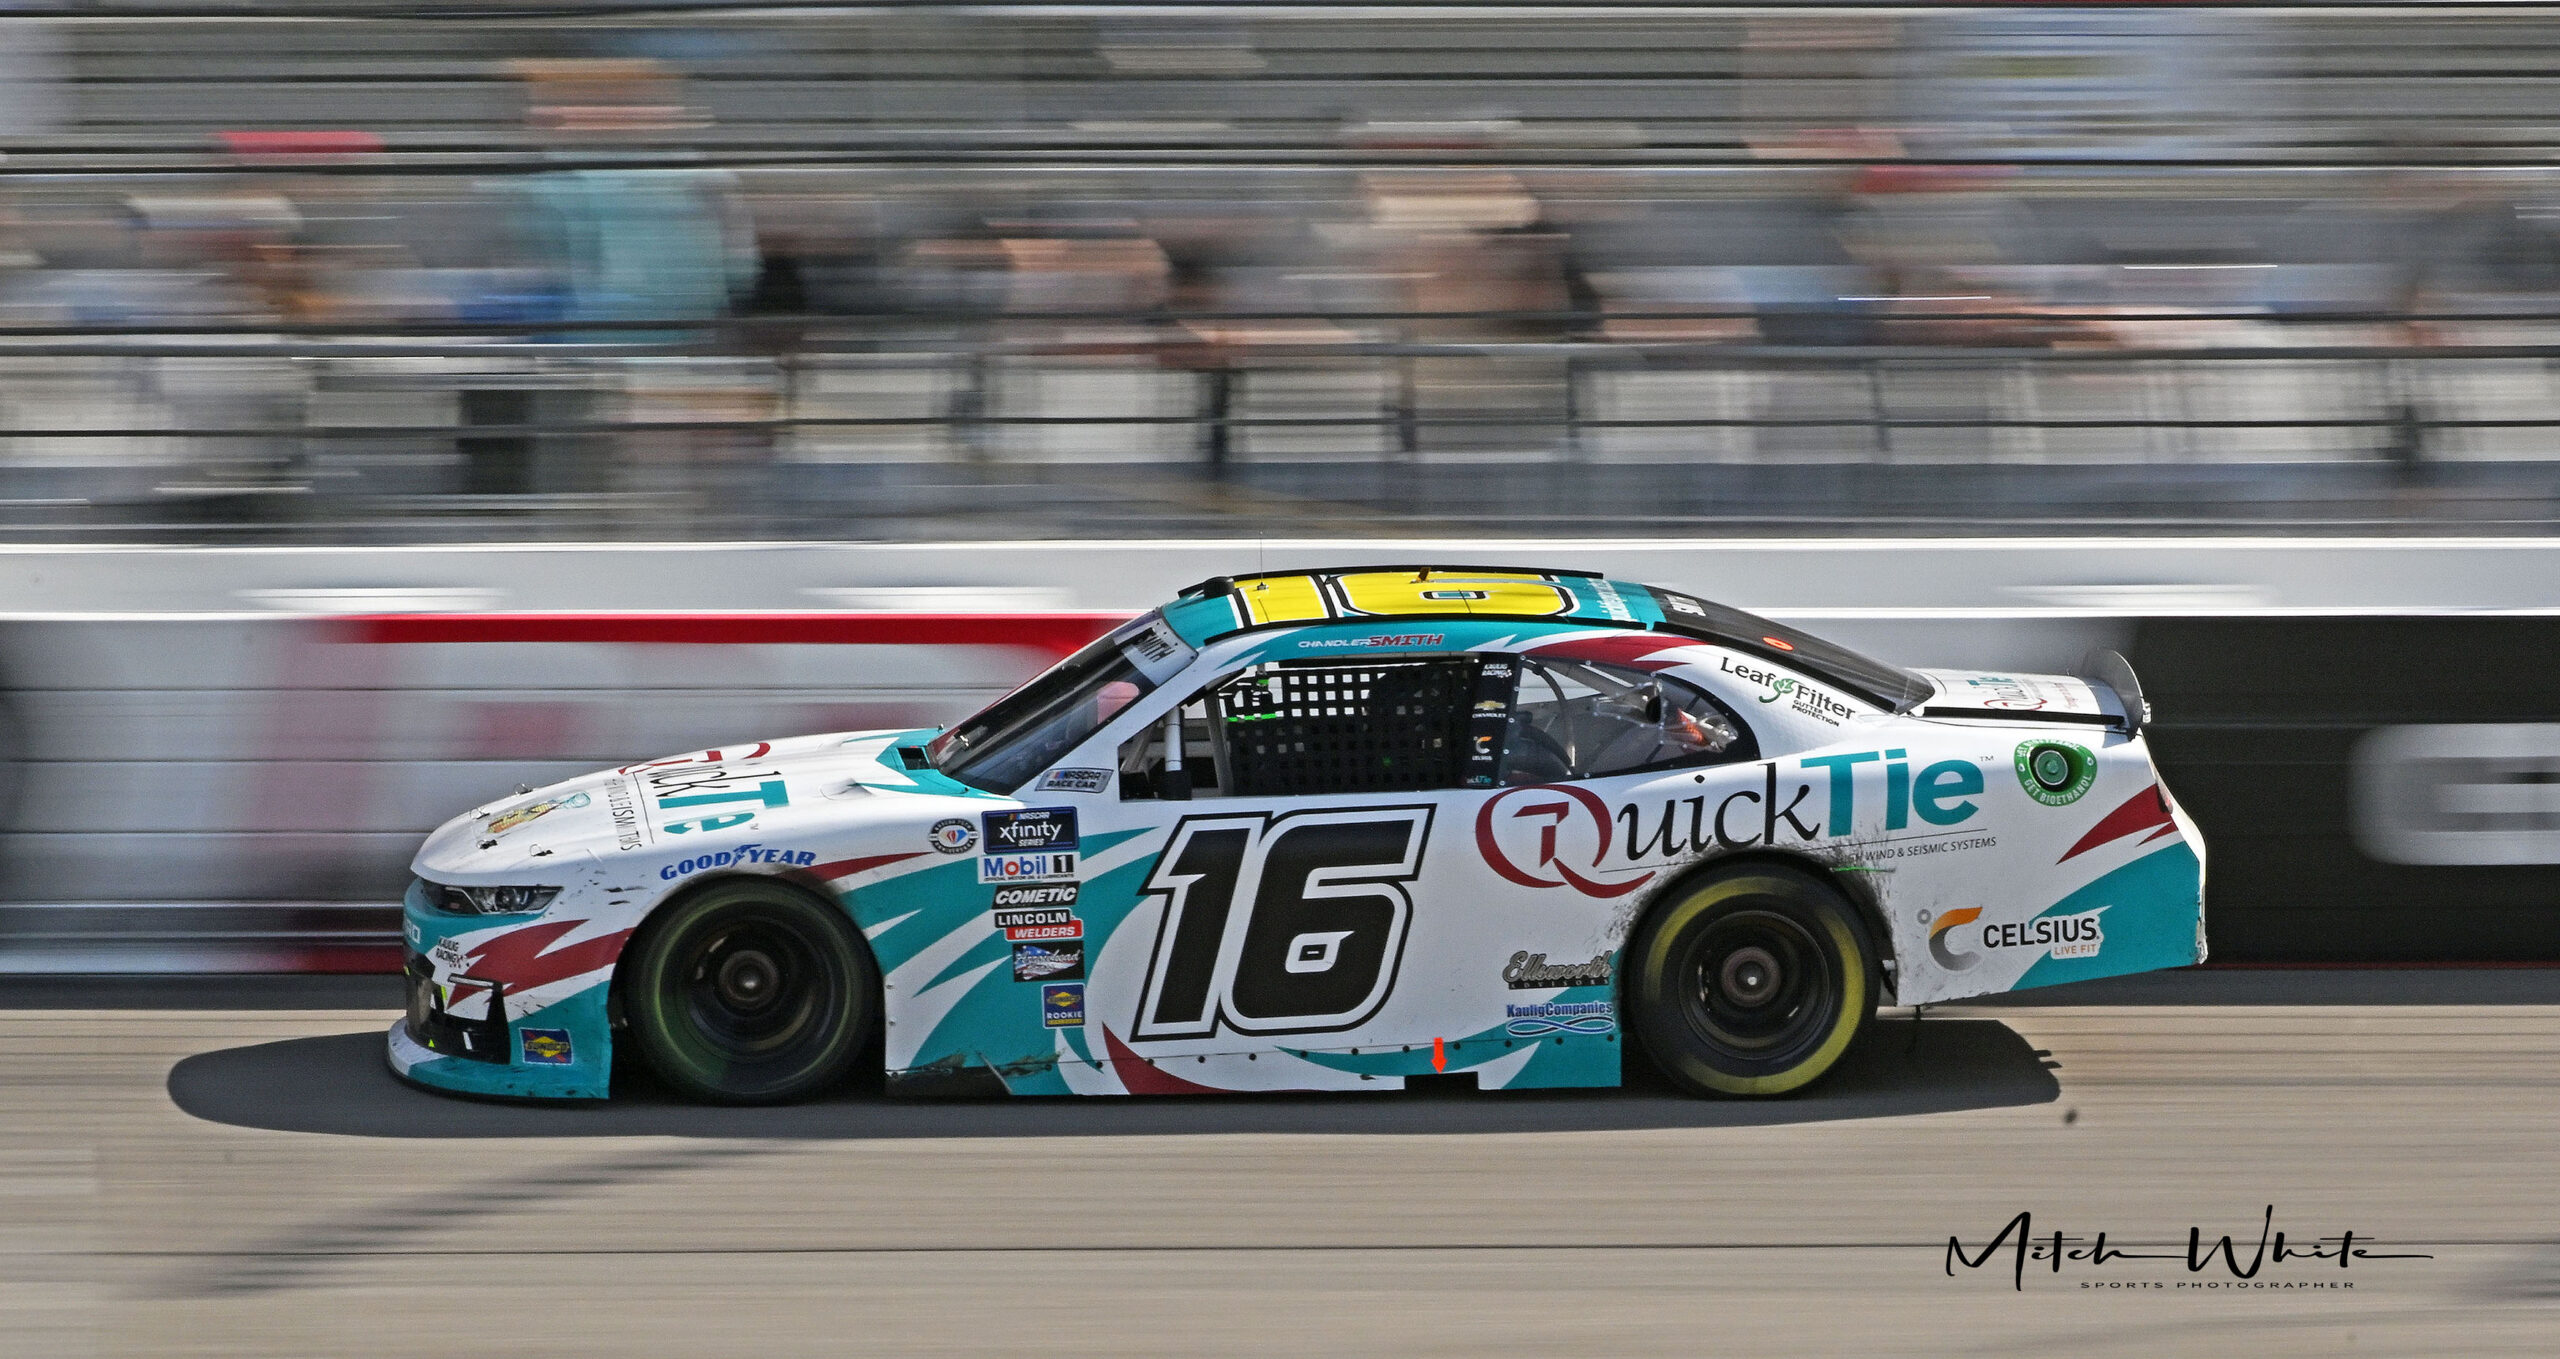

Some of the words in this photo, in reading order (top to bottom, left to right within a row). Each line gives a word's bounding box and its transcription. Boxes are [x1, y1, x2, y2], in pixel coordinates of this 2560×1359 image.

[1367, 633, 1444, 647] SMITH
[1720, 656, 1776, 687] Leaf
[1796, 684, 1856, 720] Filter
[1792, 704, 1840, 727] PROTECTION
[1793, 699, 1823, 714] GUTTER
[2024, 779, 2040, 796] GET
[2039, 775, 2092, 805] BIOETHANOL
[1000, 821, 1062, 842] xfinity
[1018, 838, 1045, 847] SERIES
[1866, 849, 1895, 860] WIND
[1897, 848, 1904, 858] &
[1907, 842, 1948, 857] SEISMIC
[1950, 836, 1997, 851] SYSTEMS
[984, 856, 1047, 877] Mobil
[995, 887, 1077, 904] COMETIC
[998, 912, 1067, 926] LINCOLN
[1129, 803, 1438, 1042] 16
[1015, 926, 1076, 938] WELDERS
[1983, 917, 2098, 948] CELSIUS
[2054, 945, 2077, 956] LIVE
[2080, 943, 2097, 954] FIT
[1502, 950, 1613, 982] Ellsworth
[1047, 1011, 1082, 1020] ROOKIE
[1506, 1001, 1613, 1017] KauligCompanies
